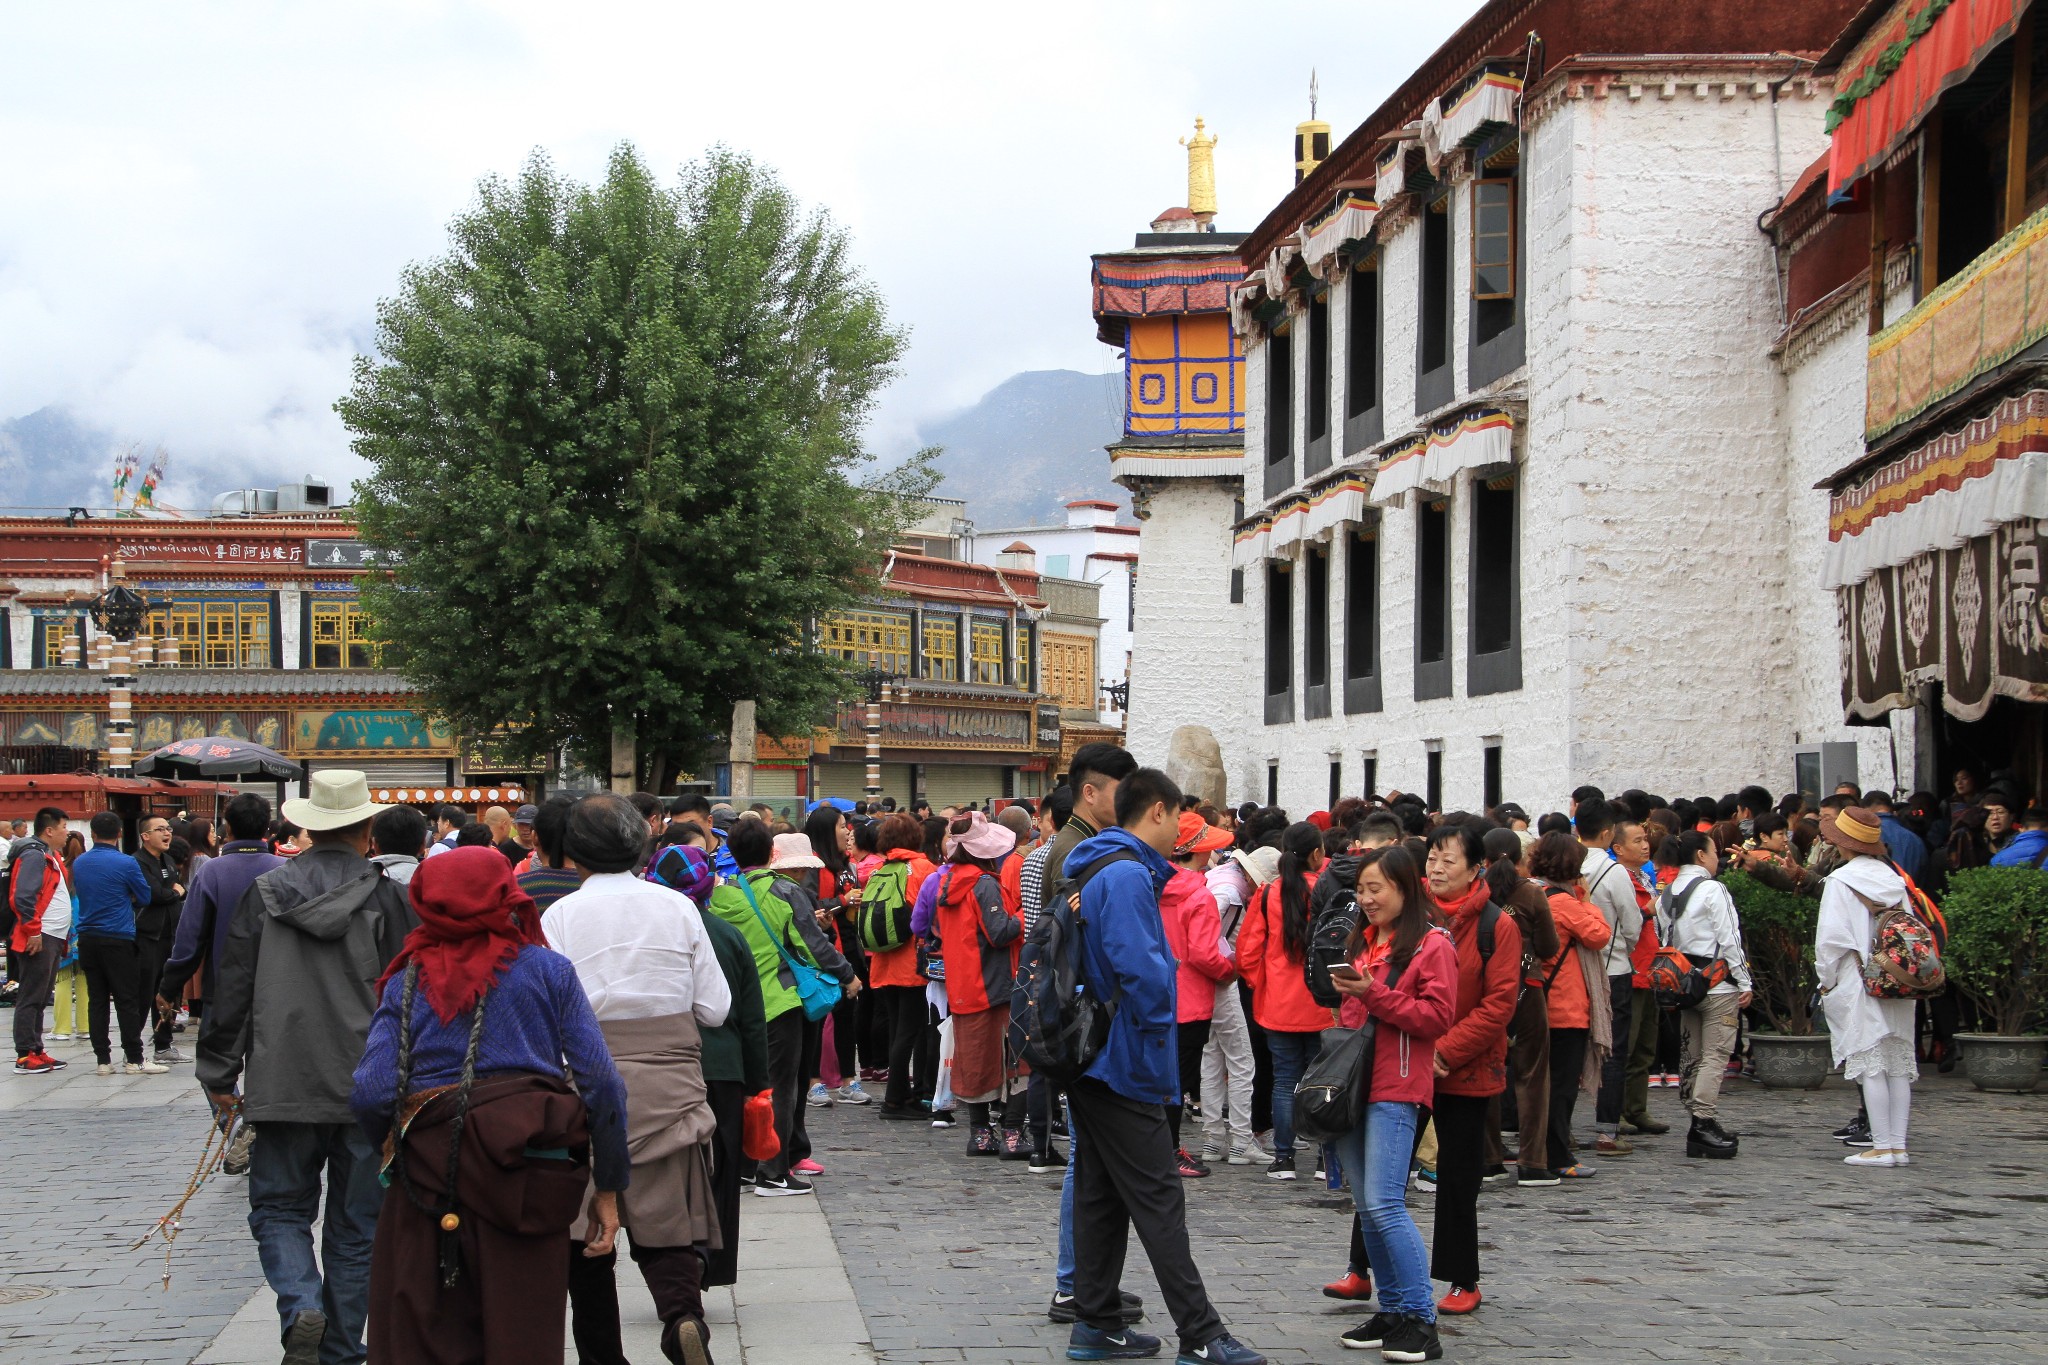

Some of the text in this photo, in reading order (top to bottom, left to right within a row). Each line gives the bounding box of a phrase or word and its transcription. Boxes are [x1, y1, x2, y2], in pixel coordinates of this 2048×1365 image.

[214, 543, 302, 561] 鲁固阿妈餐厅
[19, 713, 279, 749] 八廓购物天堂
